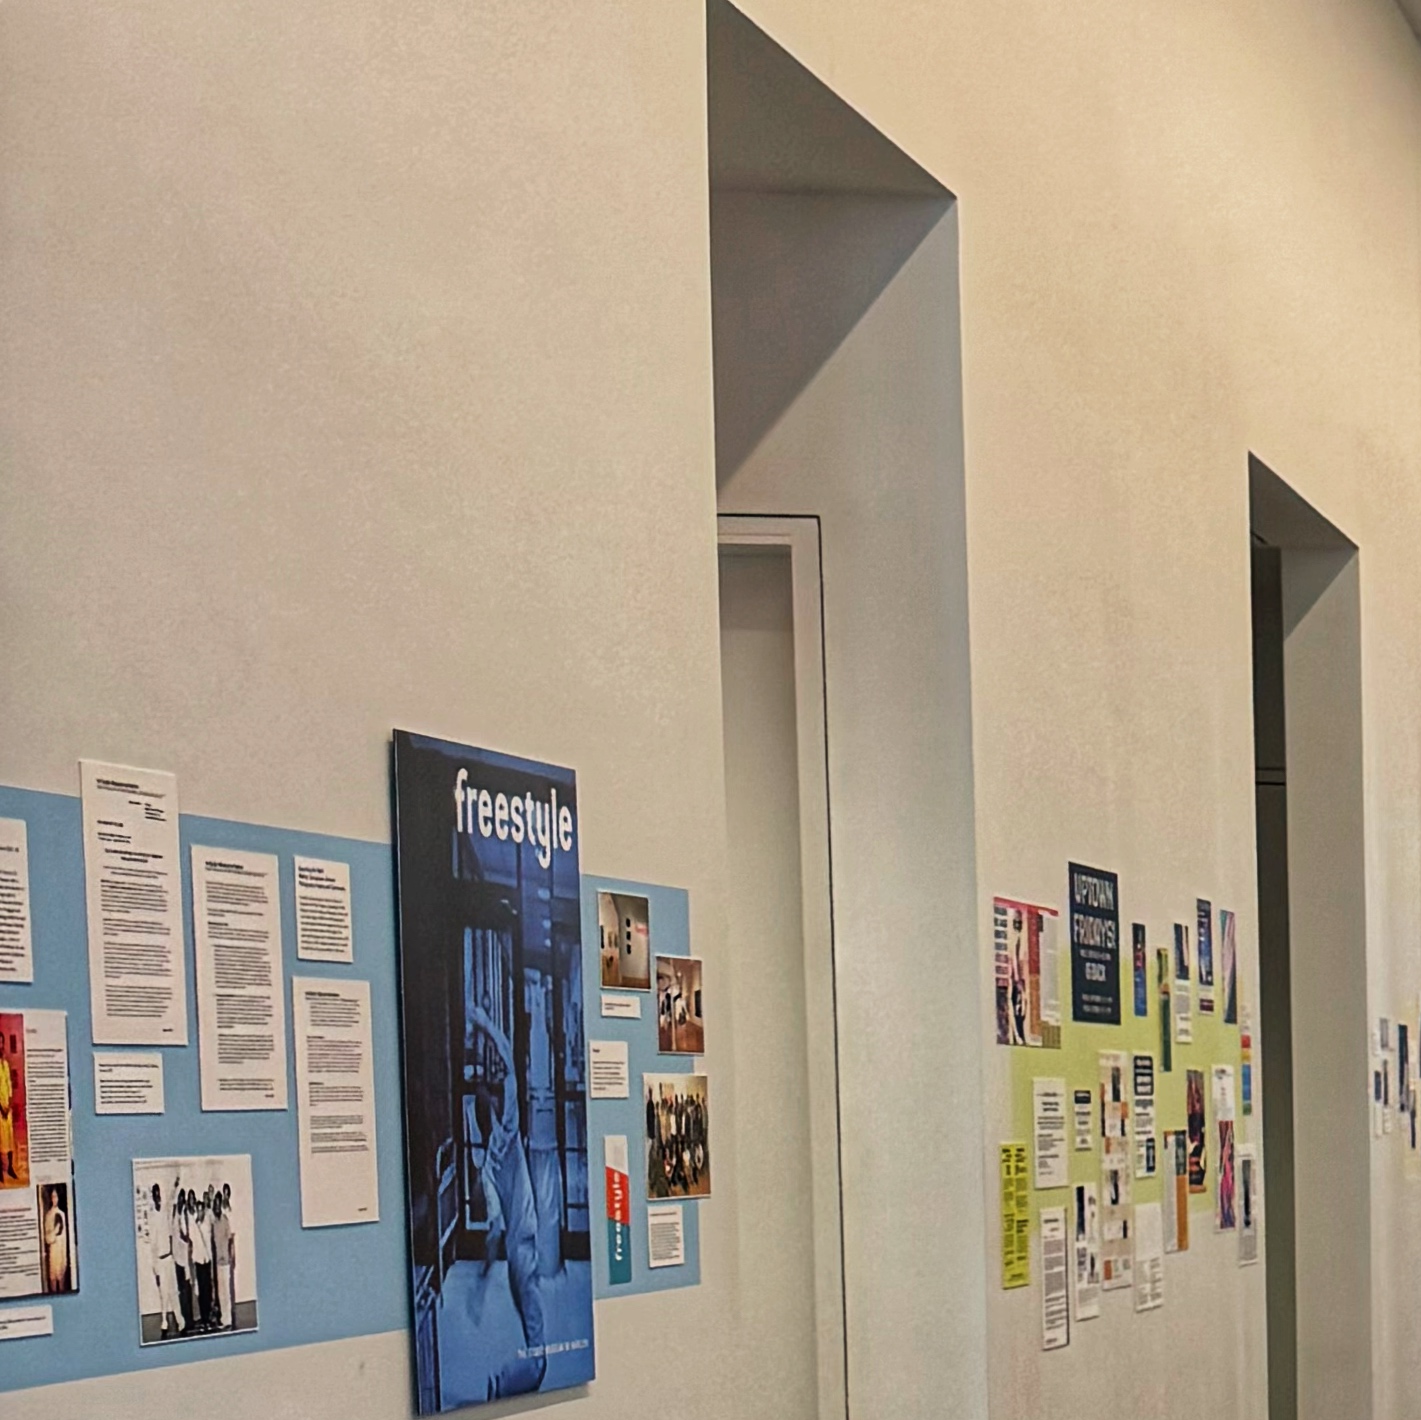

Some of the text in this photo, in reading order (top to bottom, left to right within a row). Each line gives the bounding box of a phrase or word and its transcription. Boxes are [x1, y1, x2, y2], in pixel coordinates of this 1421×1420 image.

[454, 767, 573, 869] freestyle
[1074, 872, 1115, 911] UPTOWN
[612, 1170, 623, 1261] freestyle
